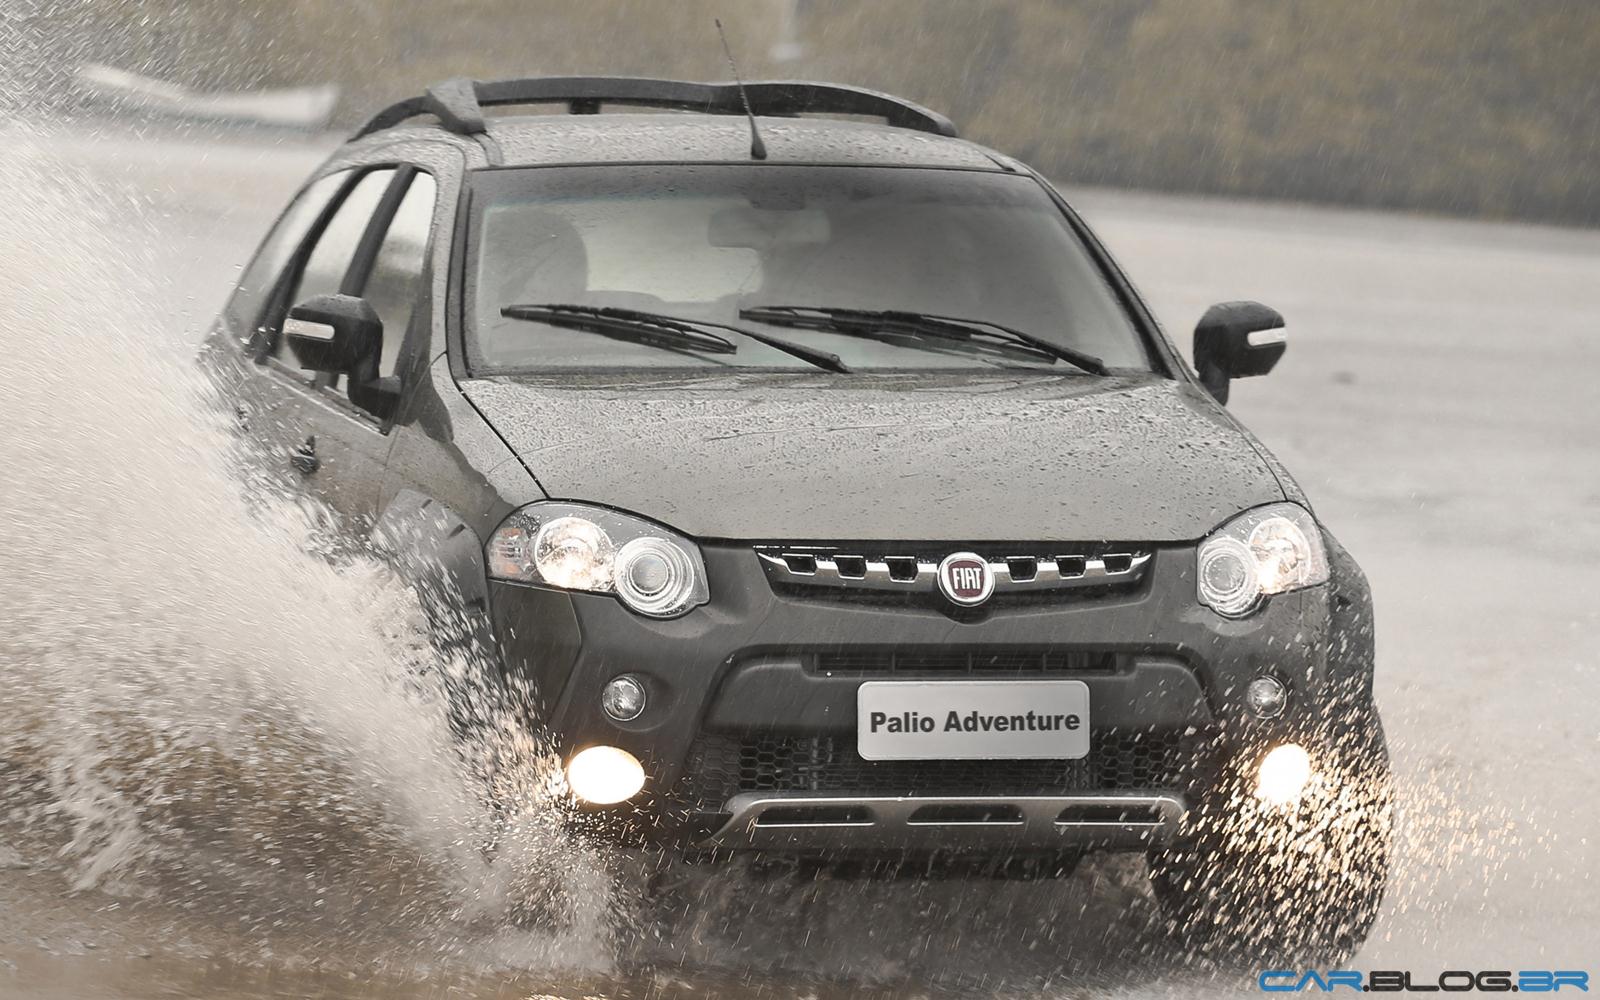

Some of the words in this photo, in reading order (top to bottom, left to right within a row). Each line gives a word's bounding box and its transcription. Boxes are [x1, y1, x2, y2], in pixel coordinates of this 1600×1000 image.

[952, 567, 982, 590] FIAT
[870, 711, 935, 733] Palio
[943, 710, 1081, 732] Adventure
